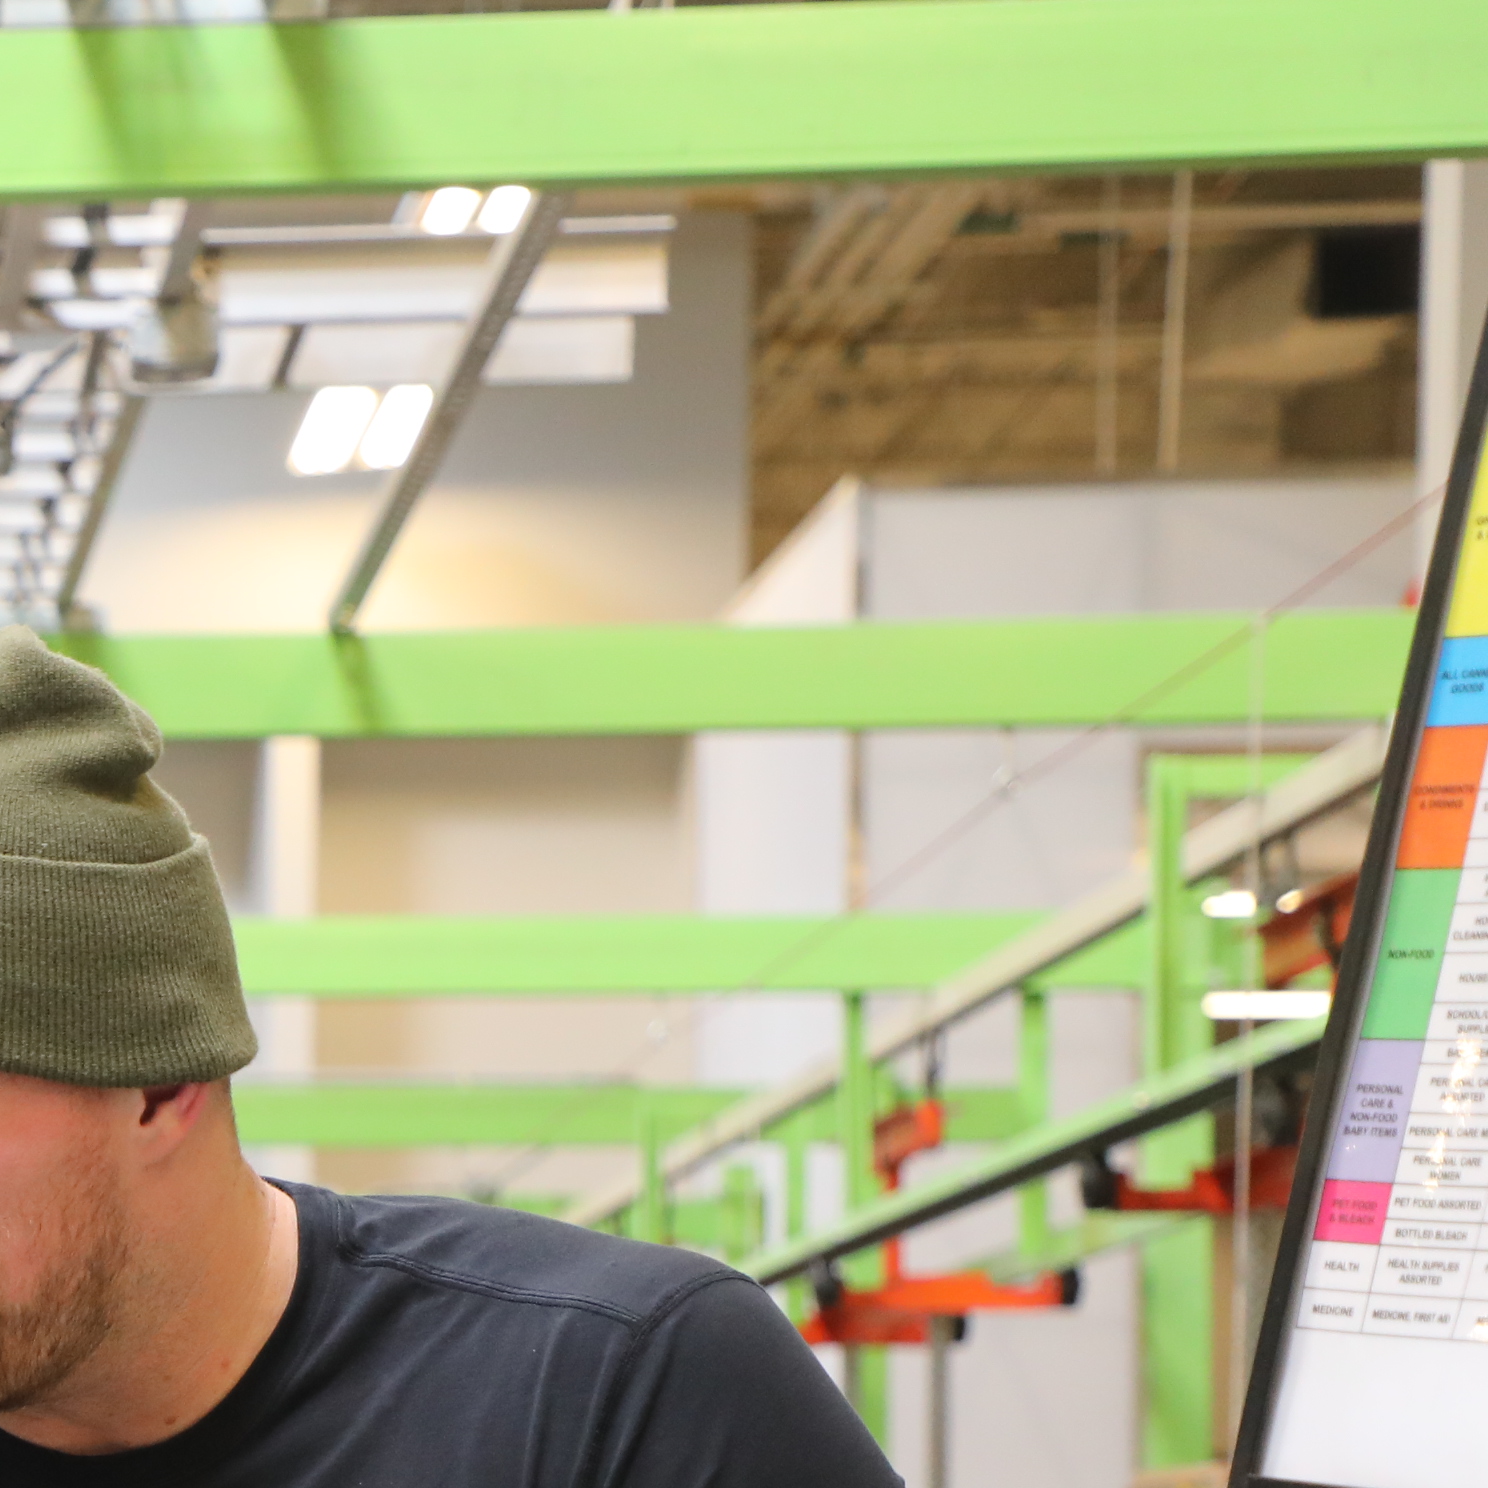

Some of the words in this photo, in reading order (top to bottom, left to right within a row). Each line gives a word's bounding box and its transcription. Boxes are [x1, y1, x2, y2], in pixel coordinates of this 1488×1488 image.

[1387, 949, 1435, 960] NON-FOOD
[1356, 1083, 1404, 1095] PERSONAL
[1361, 1099, 1385, 1109] CARE
[1350, 1112, 1398, 1123] NON-FOOD
[1343, 1126, 1369, 1136] BABY
[1370, 1127, 1398, 1138] ITEMS
[1394, 1197, 1411, 1208] PET
[1413, 1198, 1436, 1209] FOOD
[1437, 1200, 1482, 1211] ASSORTED
[1395, 1228, 1434, 1239] BOTTLED
[1435, 1230, 1468, 1240] BLEACH
[1323, 1260, 1360, 1272] HEALTH
[1387, 1259, 1420, 1270] HEALTH
[1422, 1261, 1460, 1272] SUPPLIES
[1399, 1275, 1443, 1286] ASSORTED
[1312, 1304, 1354, 1317] MEDICINE
